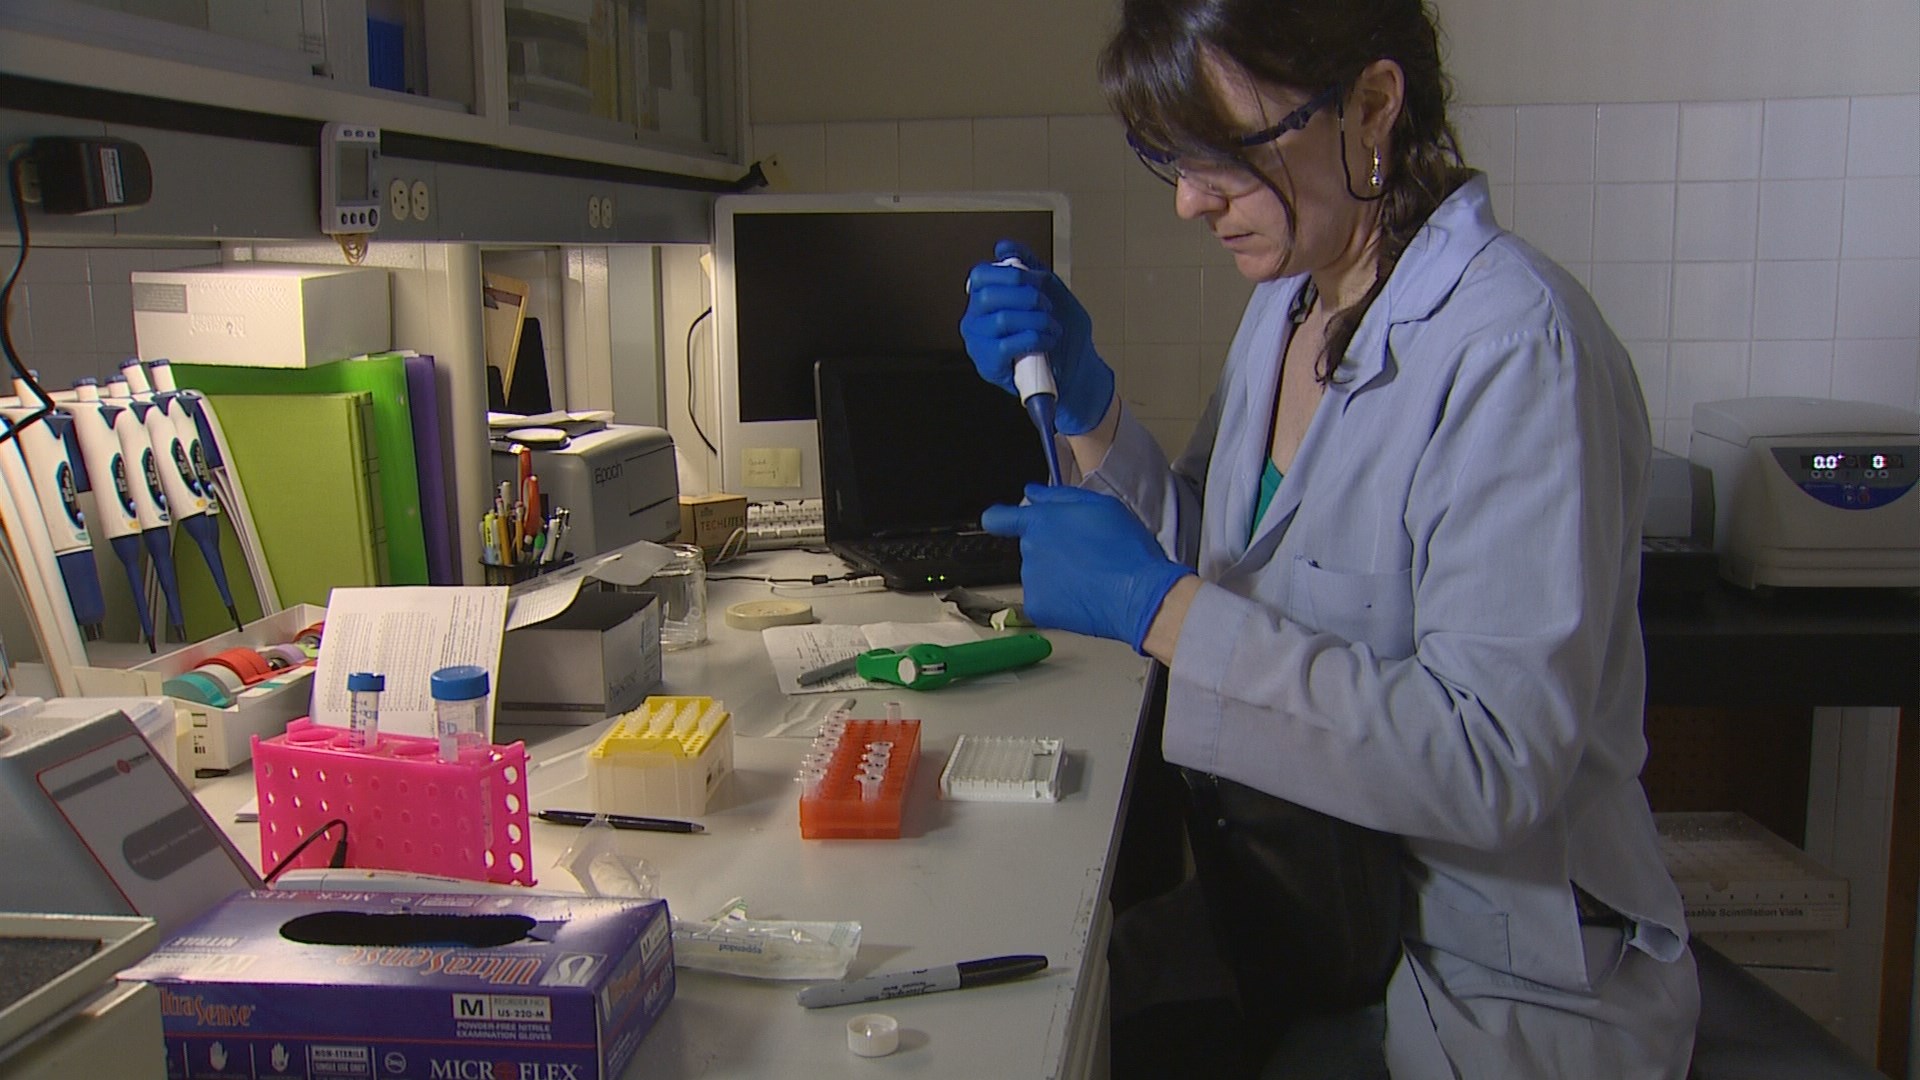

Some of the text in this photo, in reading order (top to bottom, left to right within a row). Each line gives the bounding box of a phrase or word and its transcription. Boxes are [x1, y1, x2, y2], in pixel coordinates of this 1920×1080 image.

[594, 461, 624, 487] Epoch
[336, 947, 543, 985] UltraSense
[160, 988, 252, 1027] ltraSense
[460, 999, 483, 1017] M
[497, 1009, 544, 1018] US-220-M
[456, 1021, 551, 1035] POWDER-FREE NITRILE
[456, 1030, 552, 1042] EXAMINATION GLOVES
